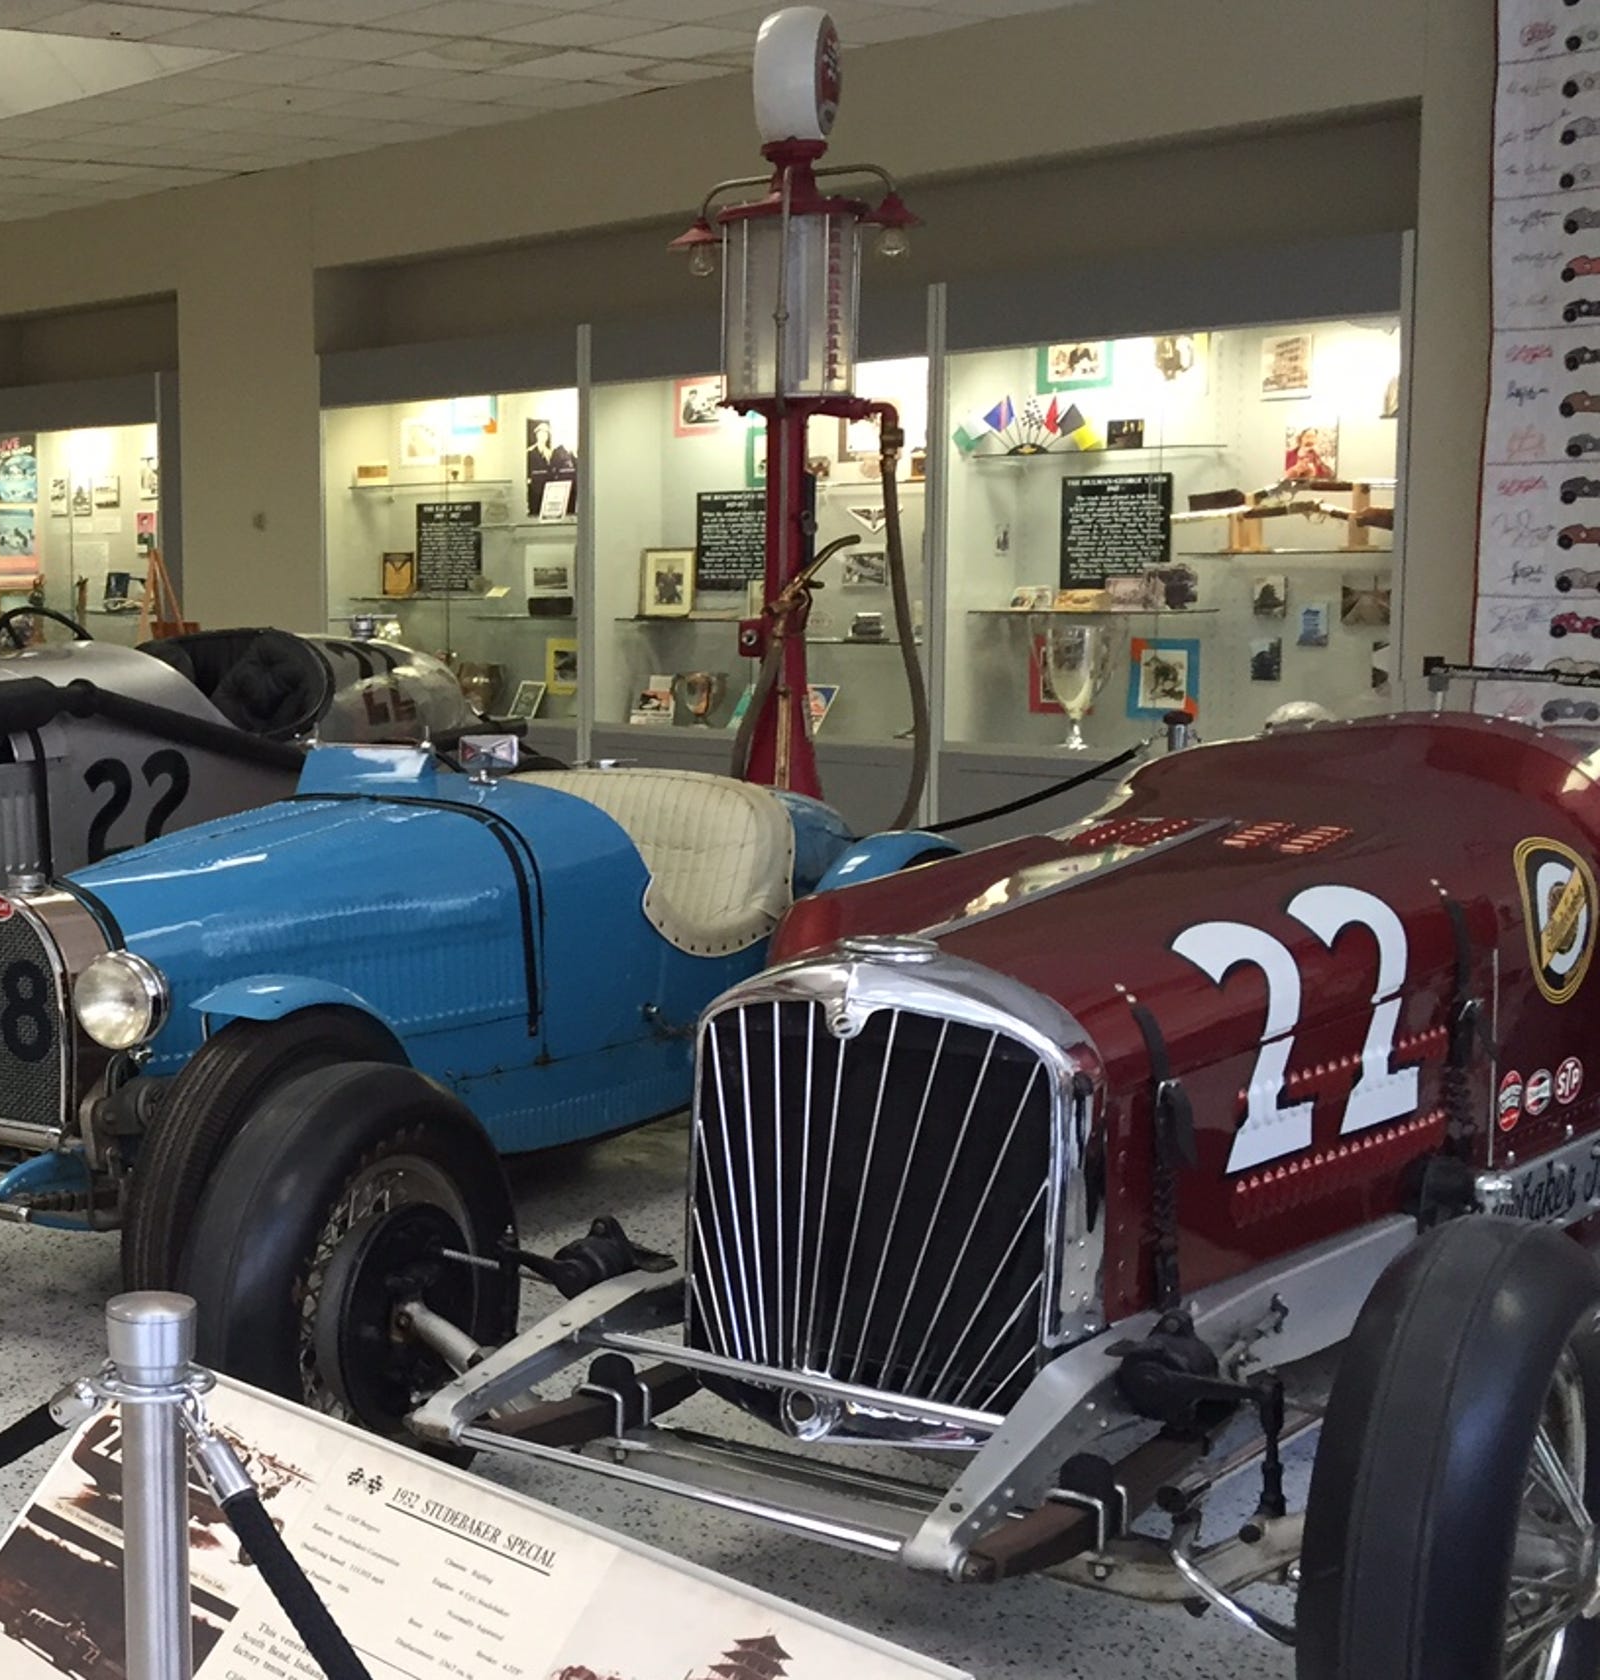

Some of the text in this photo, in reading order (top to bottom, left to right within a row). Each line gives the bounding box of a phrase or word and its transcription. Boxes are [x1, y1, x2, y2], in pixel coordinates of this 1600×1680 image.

[84, 749, 190, 861] 22
[1170, 884, 1420, 1175] 22
[1556, 1061, 1581, 1098] STP
[391, 1487, 557, 1569] 1932 STUDEBAKER SPECIAL
[241, 1630, 266, 1650] South
[258, 1621, 277, 1639] This
[232, 1642, 261, 1665] factory
